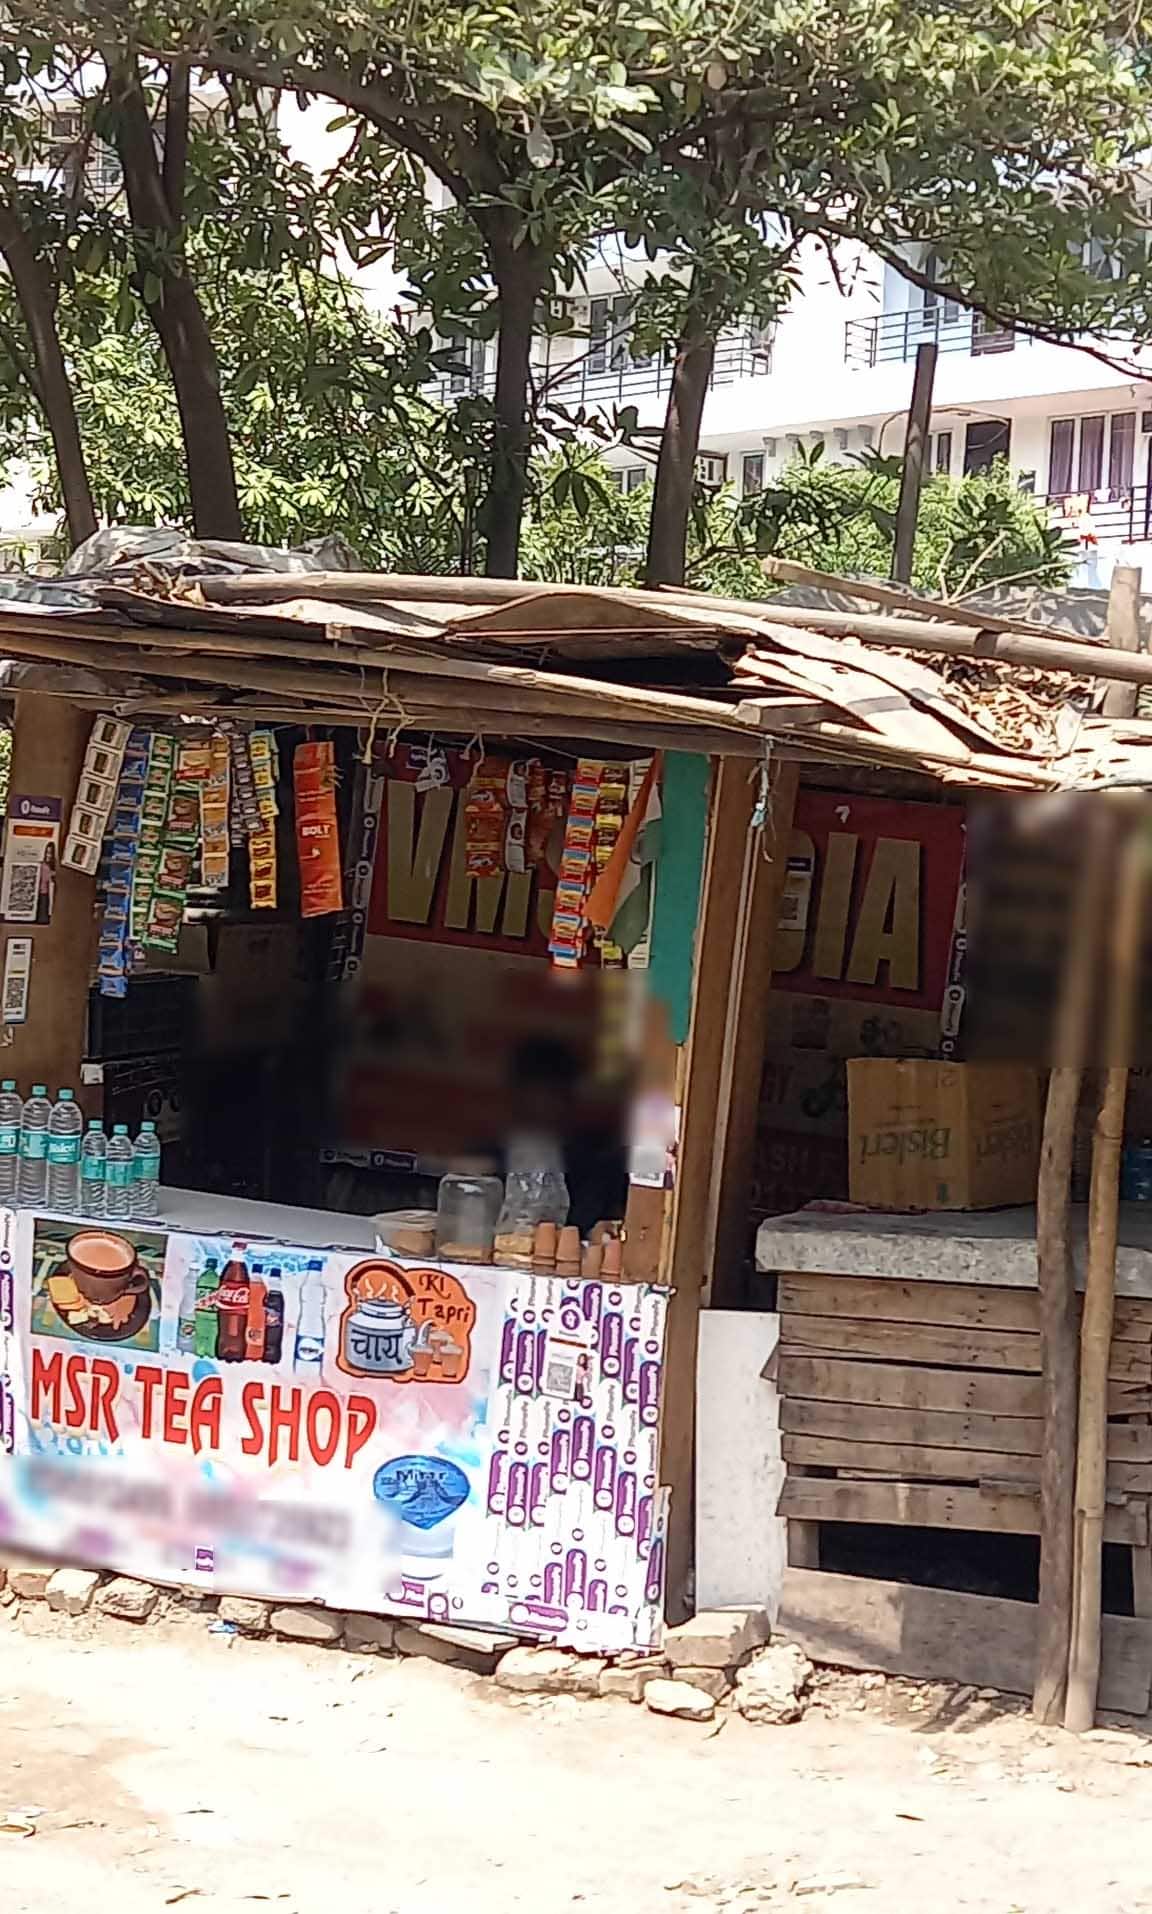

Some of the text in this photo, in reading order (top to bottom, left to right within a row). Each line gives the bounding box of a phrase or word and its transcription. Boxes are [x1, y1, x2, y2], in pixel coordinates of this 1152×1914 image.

[858, 1127, 952, 1166] Bisleri
[417, 1298, 470, 1323] Tapri
[350, 1329, 403, 1365] चाय
[32, 1348, 377, 1469] MSR TEA SHOP
